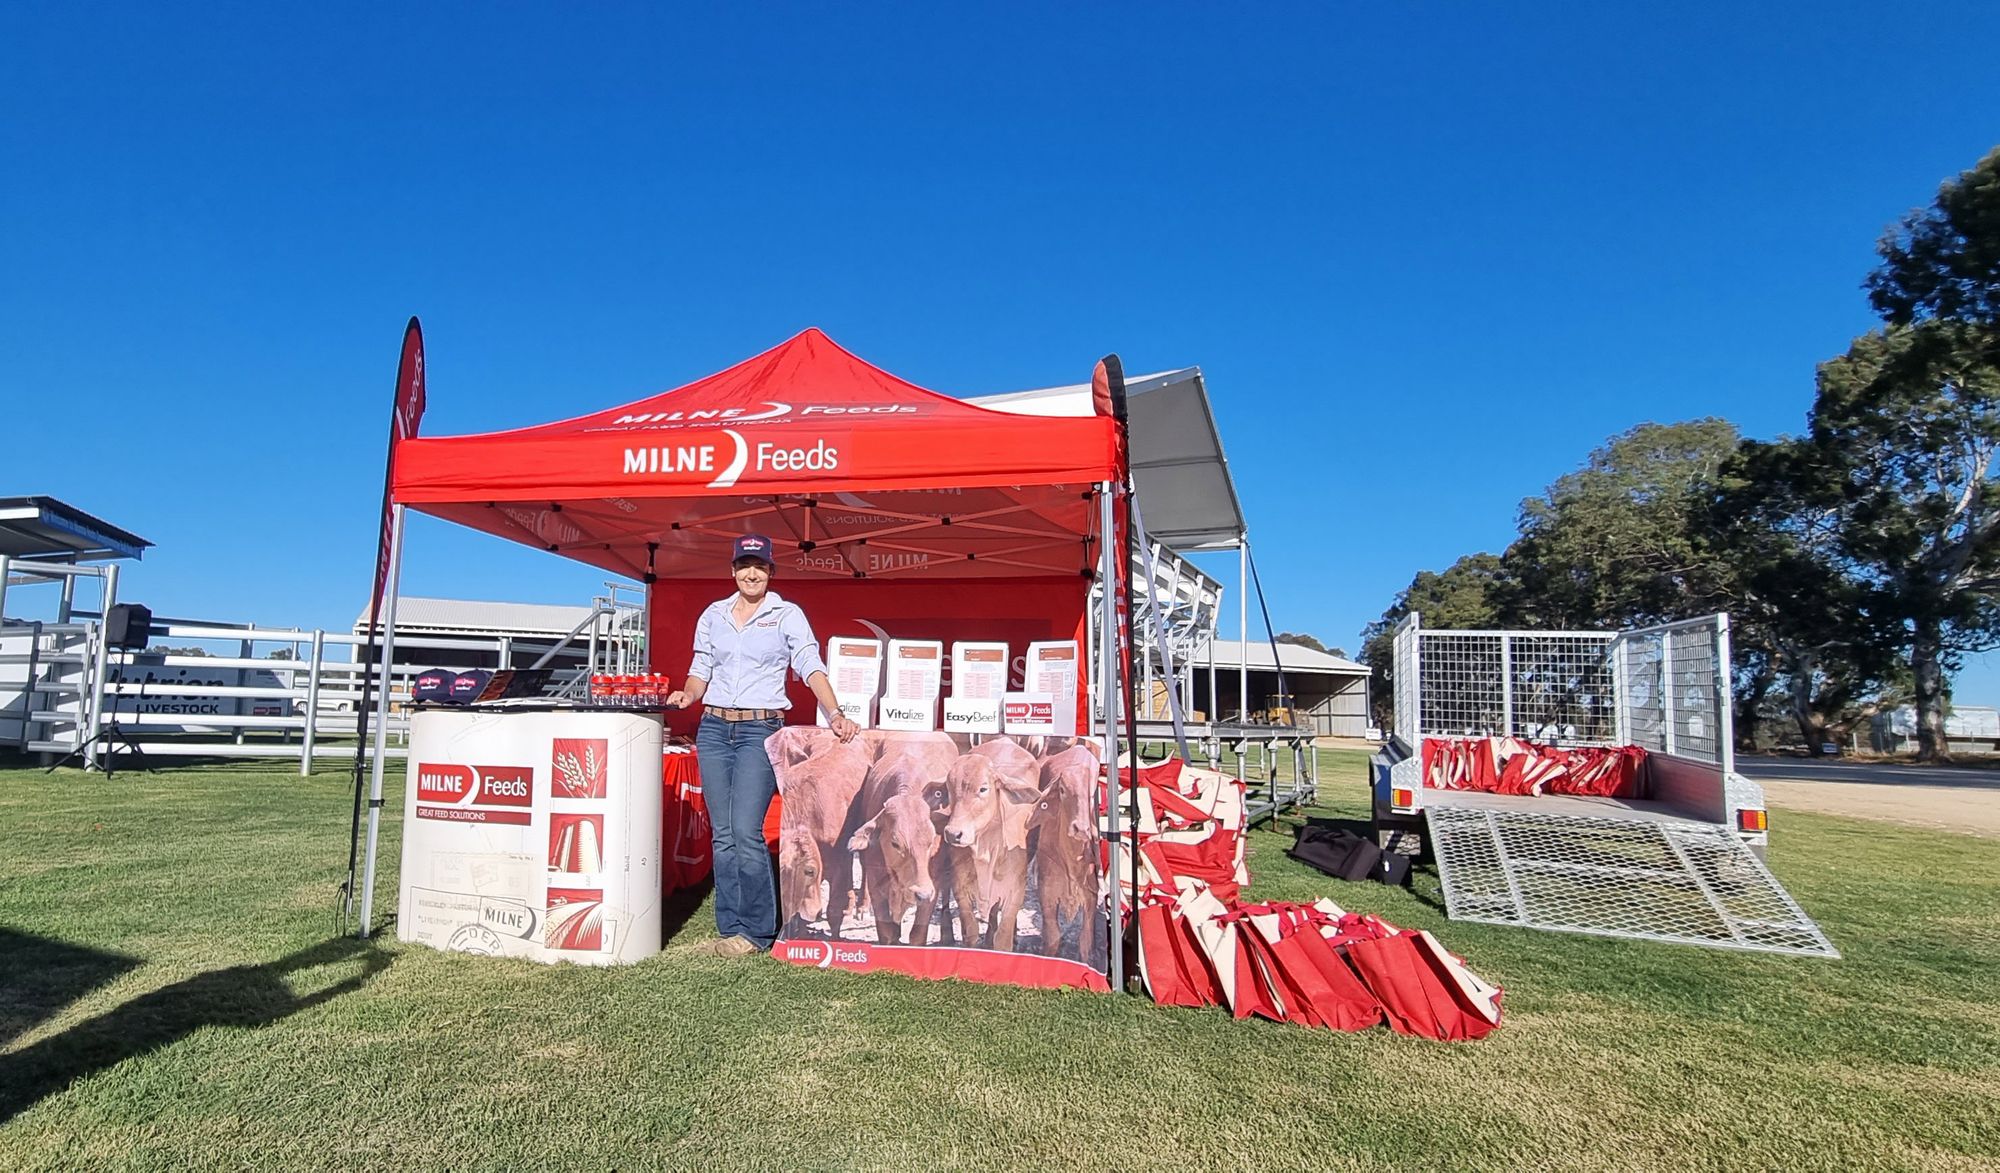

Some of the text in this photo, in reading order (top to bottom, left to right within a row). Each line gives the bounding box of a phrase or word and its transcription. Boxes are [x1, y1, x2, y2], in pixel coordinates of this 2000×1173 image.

[612, 402, 917, 425] MILNE Feeds
[623, 439, 838, 474] MILNE Feeds
[136, 704, 219, 715] LIVESTOCK
[886, 708, 924, 721] Vitalize
[946, 711, 996, 724] EasyBeef
[421, 774, 528, 797] MILNE Feeds
[418, 807, 486, 821] GREAT FEED SOLUTIONS
[484, 907, 524, 929] MILNE
[787, 946, 868, 963] MILNE Feeds
